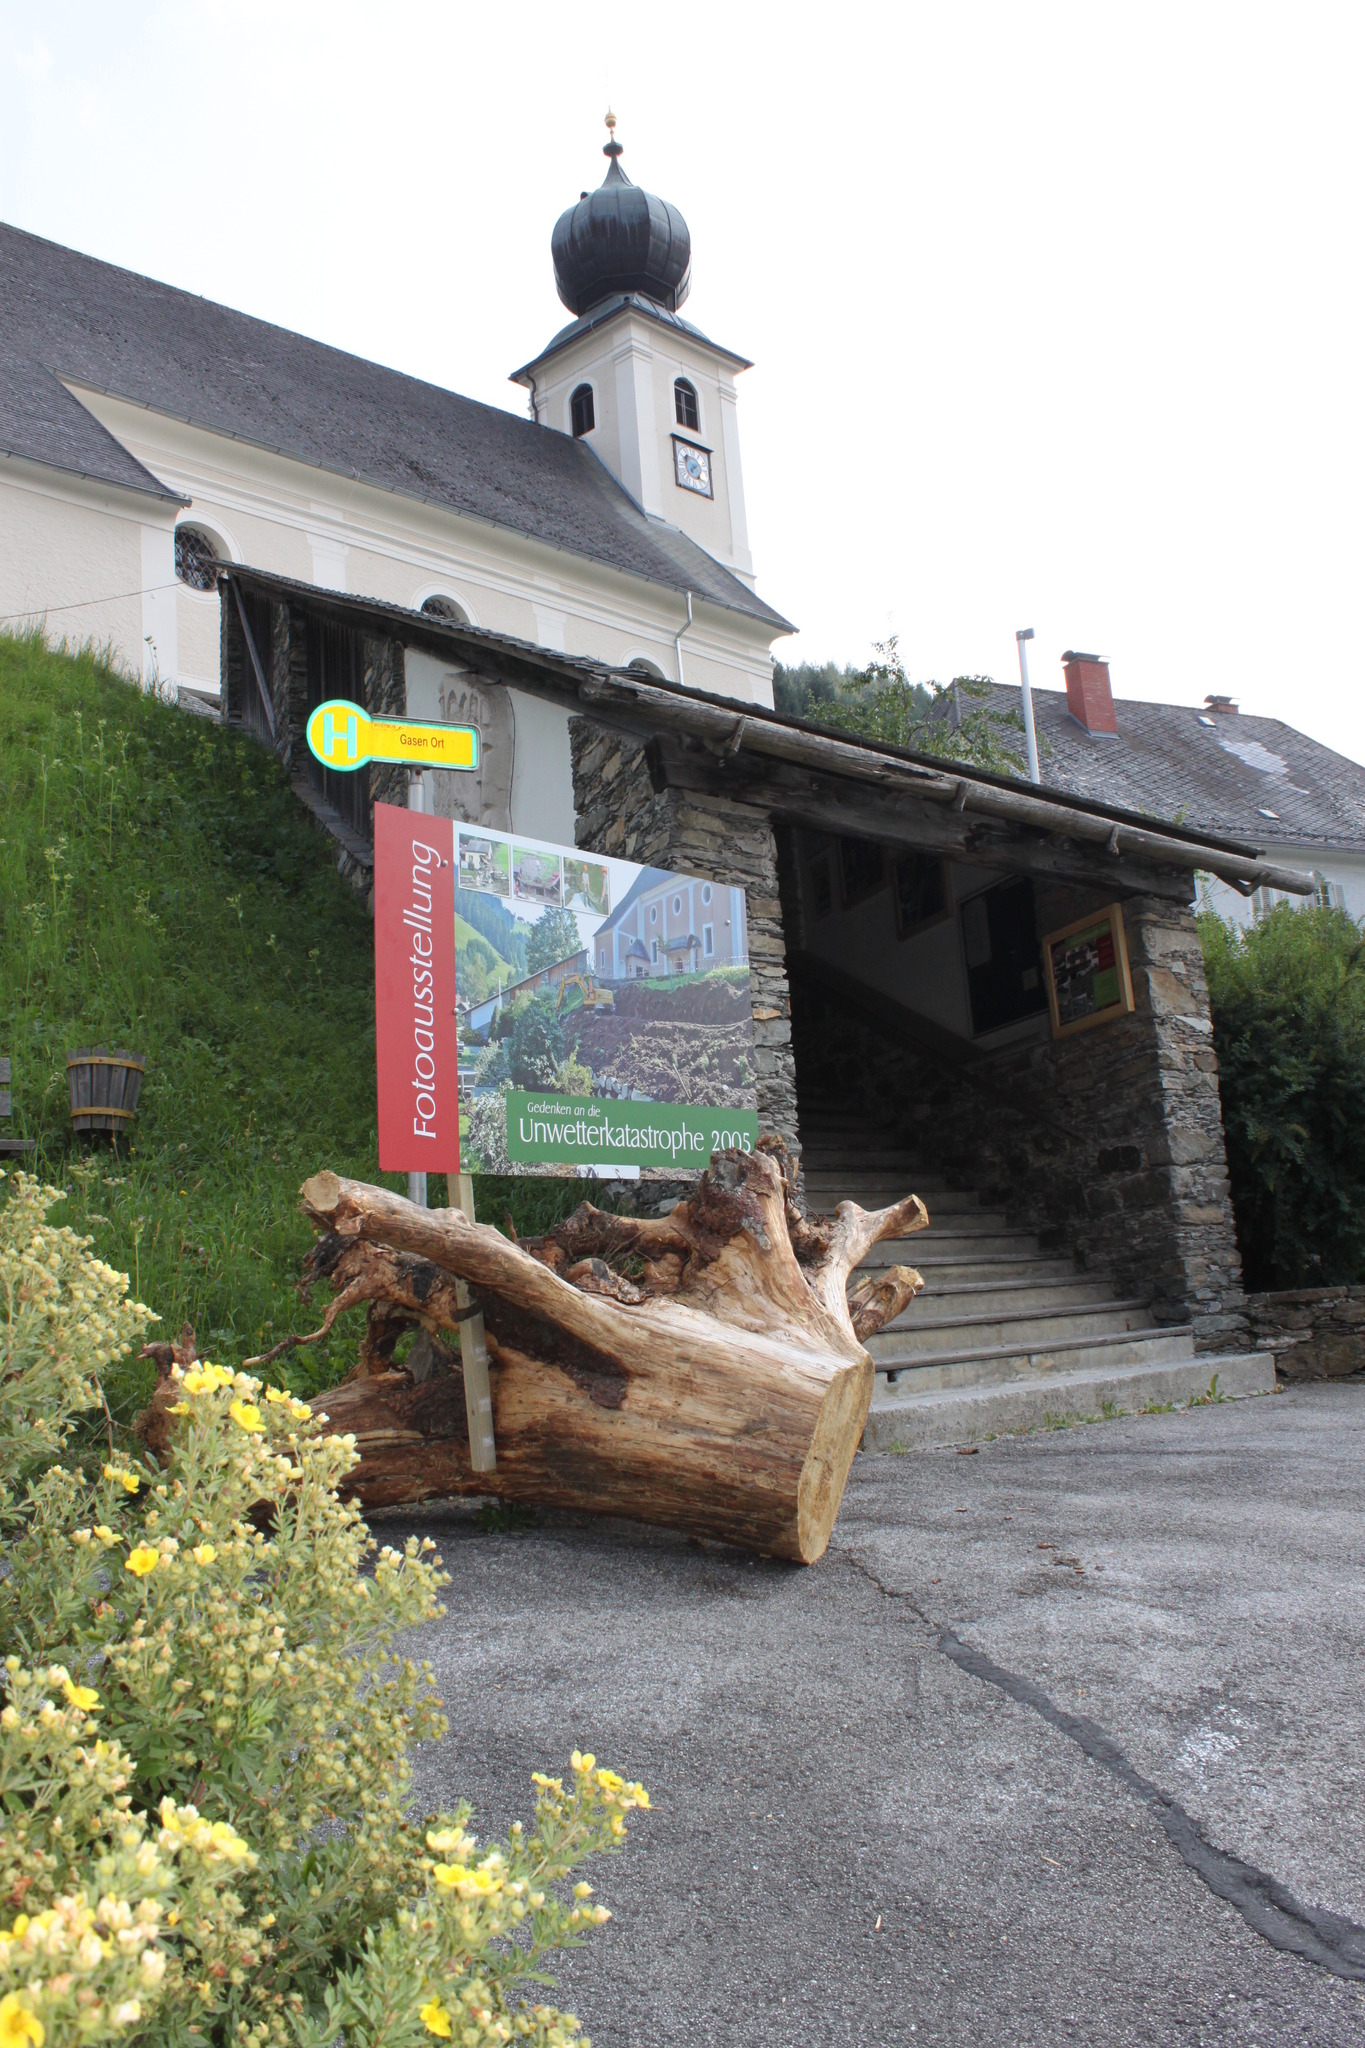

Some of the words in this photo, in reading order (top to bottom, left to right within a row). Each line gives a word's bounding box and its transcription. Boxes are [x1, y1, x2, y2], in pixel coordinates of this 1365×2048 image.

[323, 713, 357, 758] H
[400, 733, 429, 747] Gasen
[430, 736, 445, 749] Ort
[403, 839, 442, 1139] Fotoausstellung
[527, 1101, 572, 1116] Gedenken
[573, 1106, 585, 1116] an
[587, 1104, 601, 1118] die
[519, 1116, 705, 1159] Unwetterkatastrophe
[711, 1130, 751, 1153] 2005
